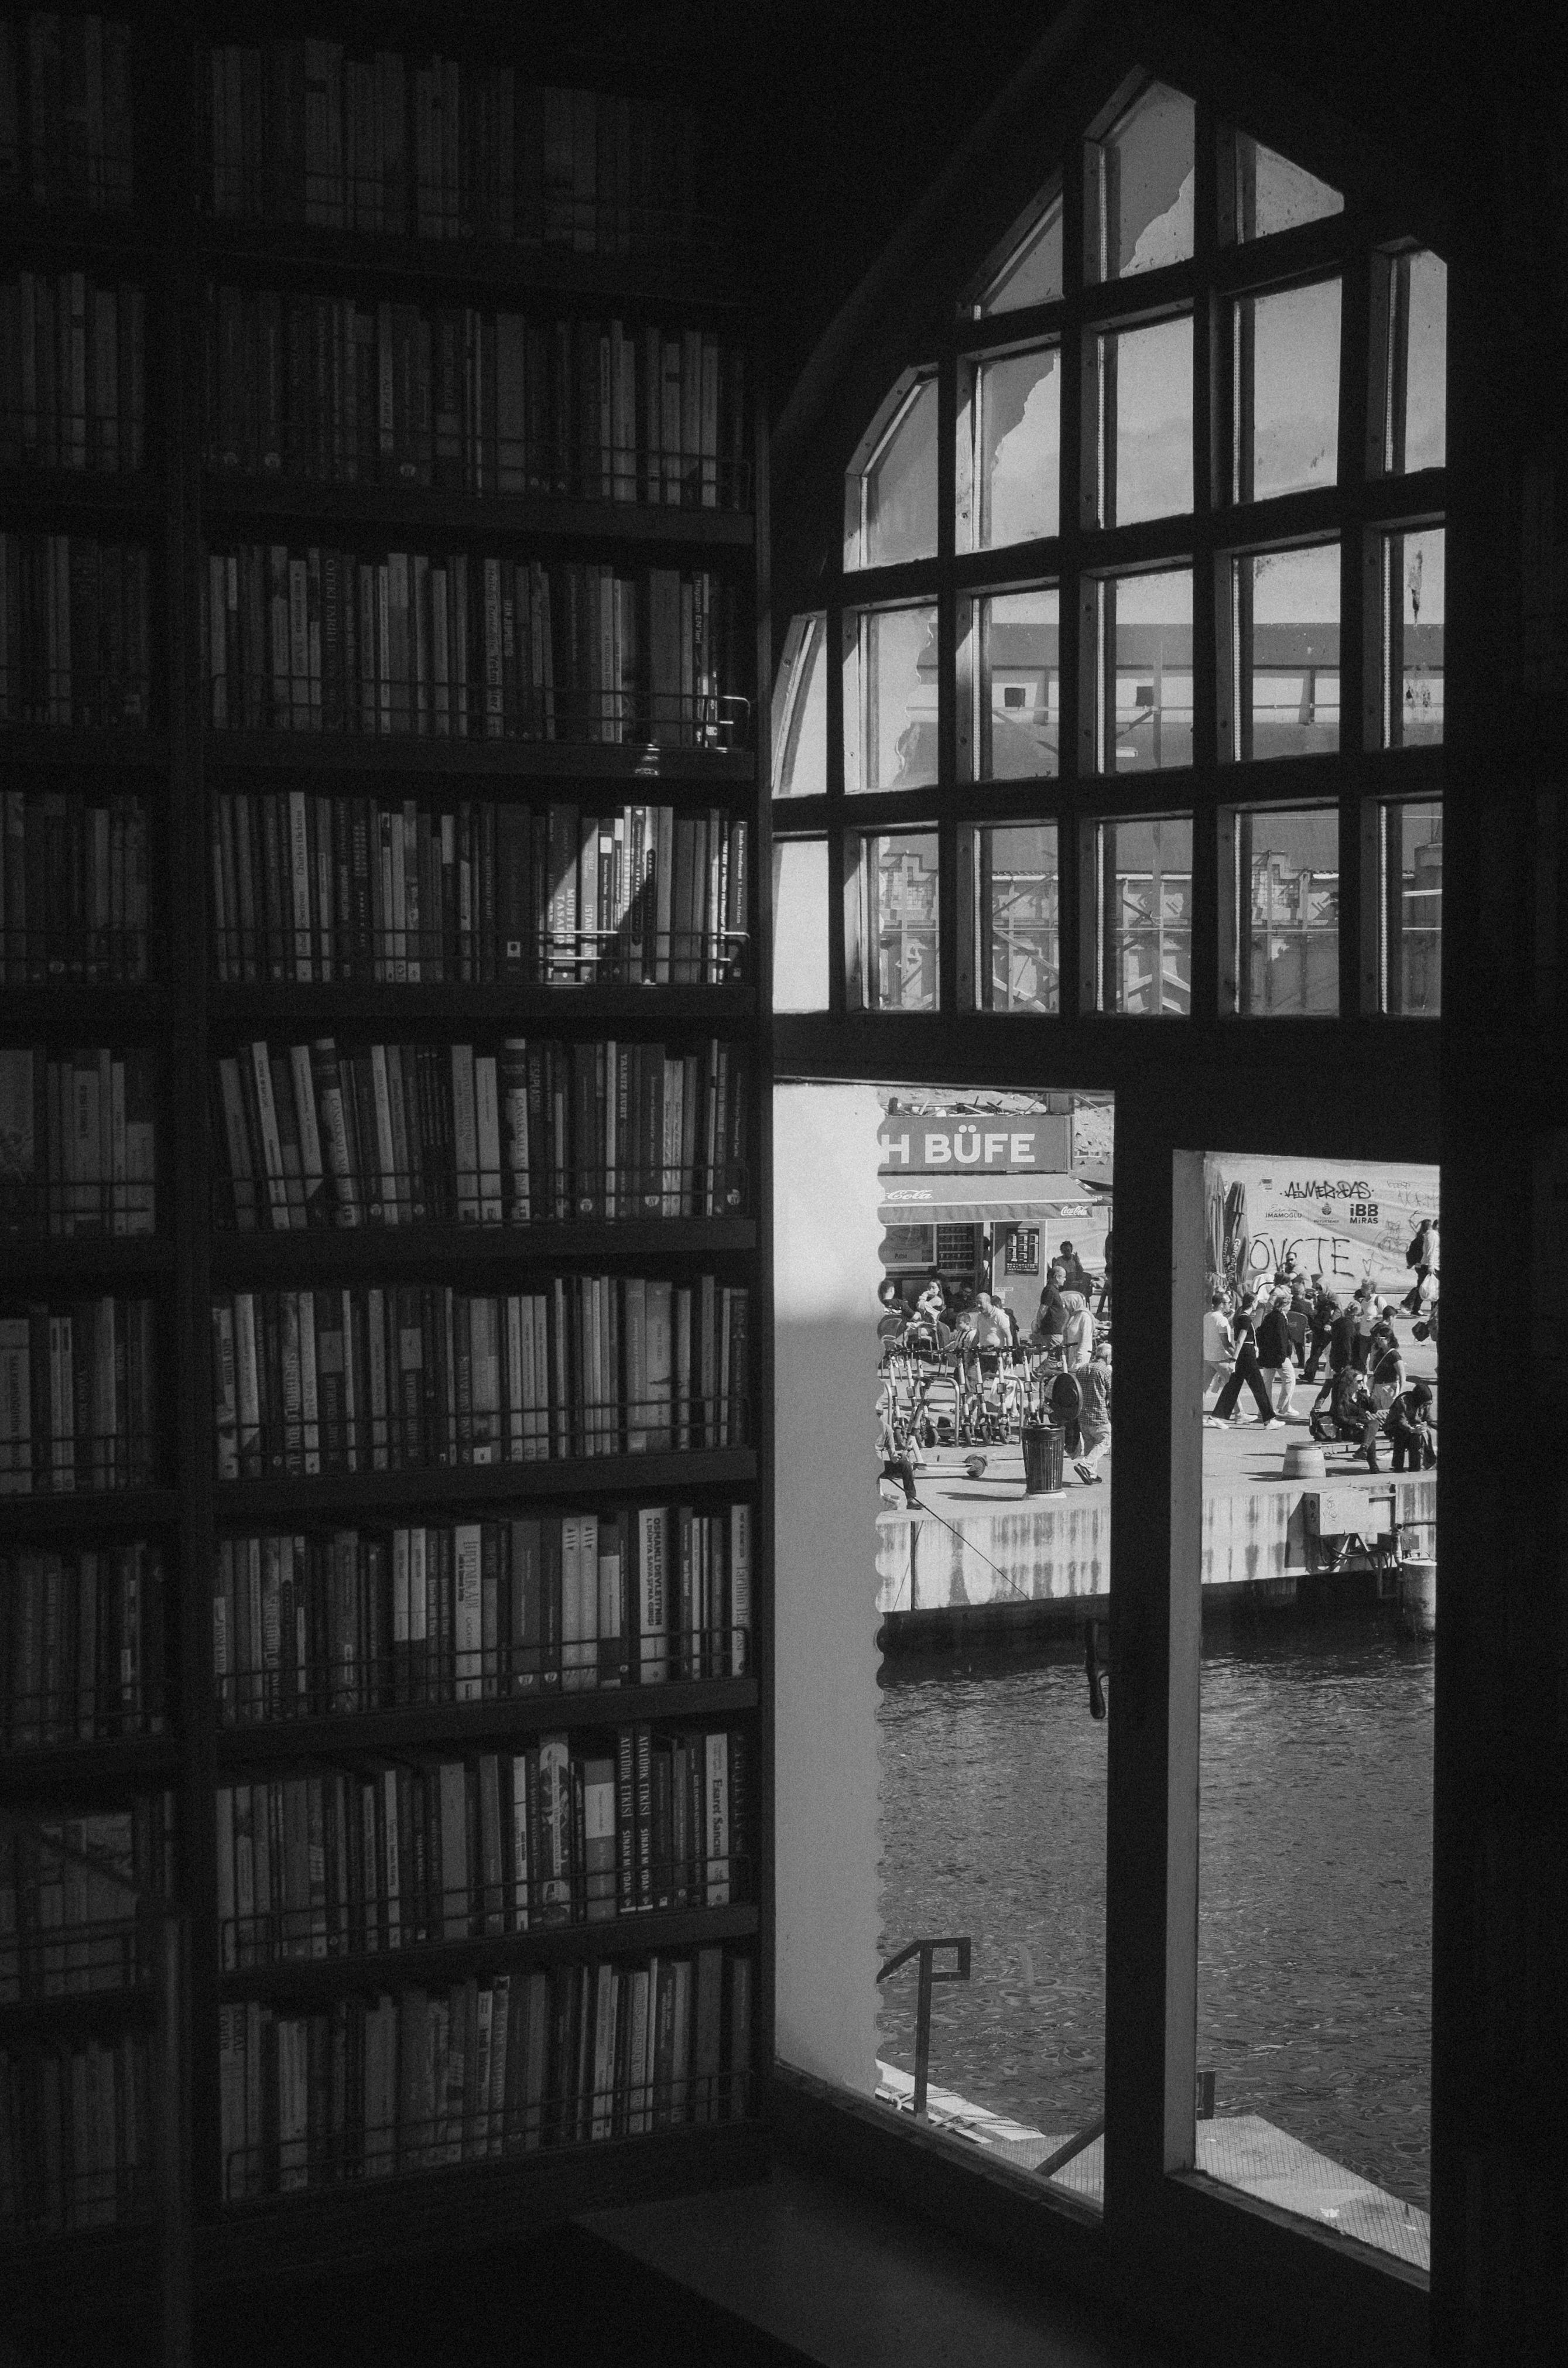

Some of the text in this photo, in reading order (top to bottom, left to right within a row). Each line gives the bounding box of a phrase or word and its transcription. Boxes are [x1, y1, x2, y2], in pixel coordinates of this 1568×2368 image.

[619, 1092, 628, 1120] KURT
[925, 1124, 1036, 1164] BÜFE
[646, 1524, 655, 1553] DÜNYA
[653, 1517, 663, 1562] OSMANLI
[620, 1736, 632, 1782] ATATÜRK
[638, 1734, 651, 1780] ATATÜRK
[713, 1778, 723, 1815] Esaret
[622, 1829, 631, 1857] SİNAN
[640, 1828, 649, 1855] SİNAN
